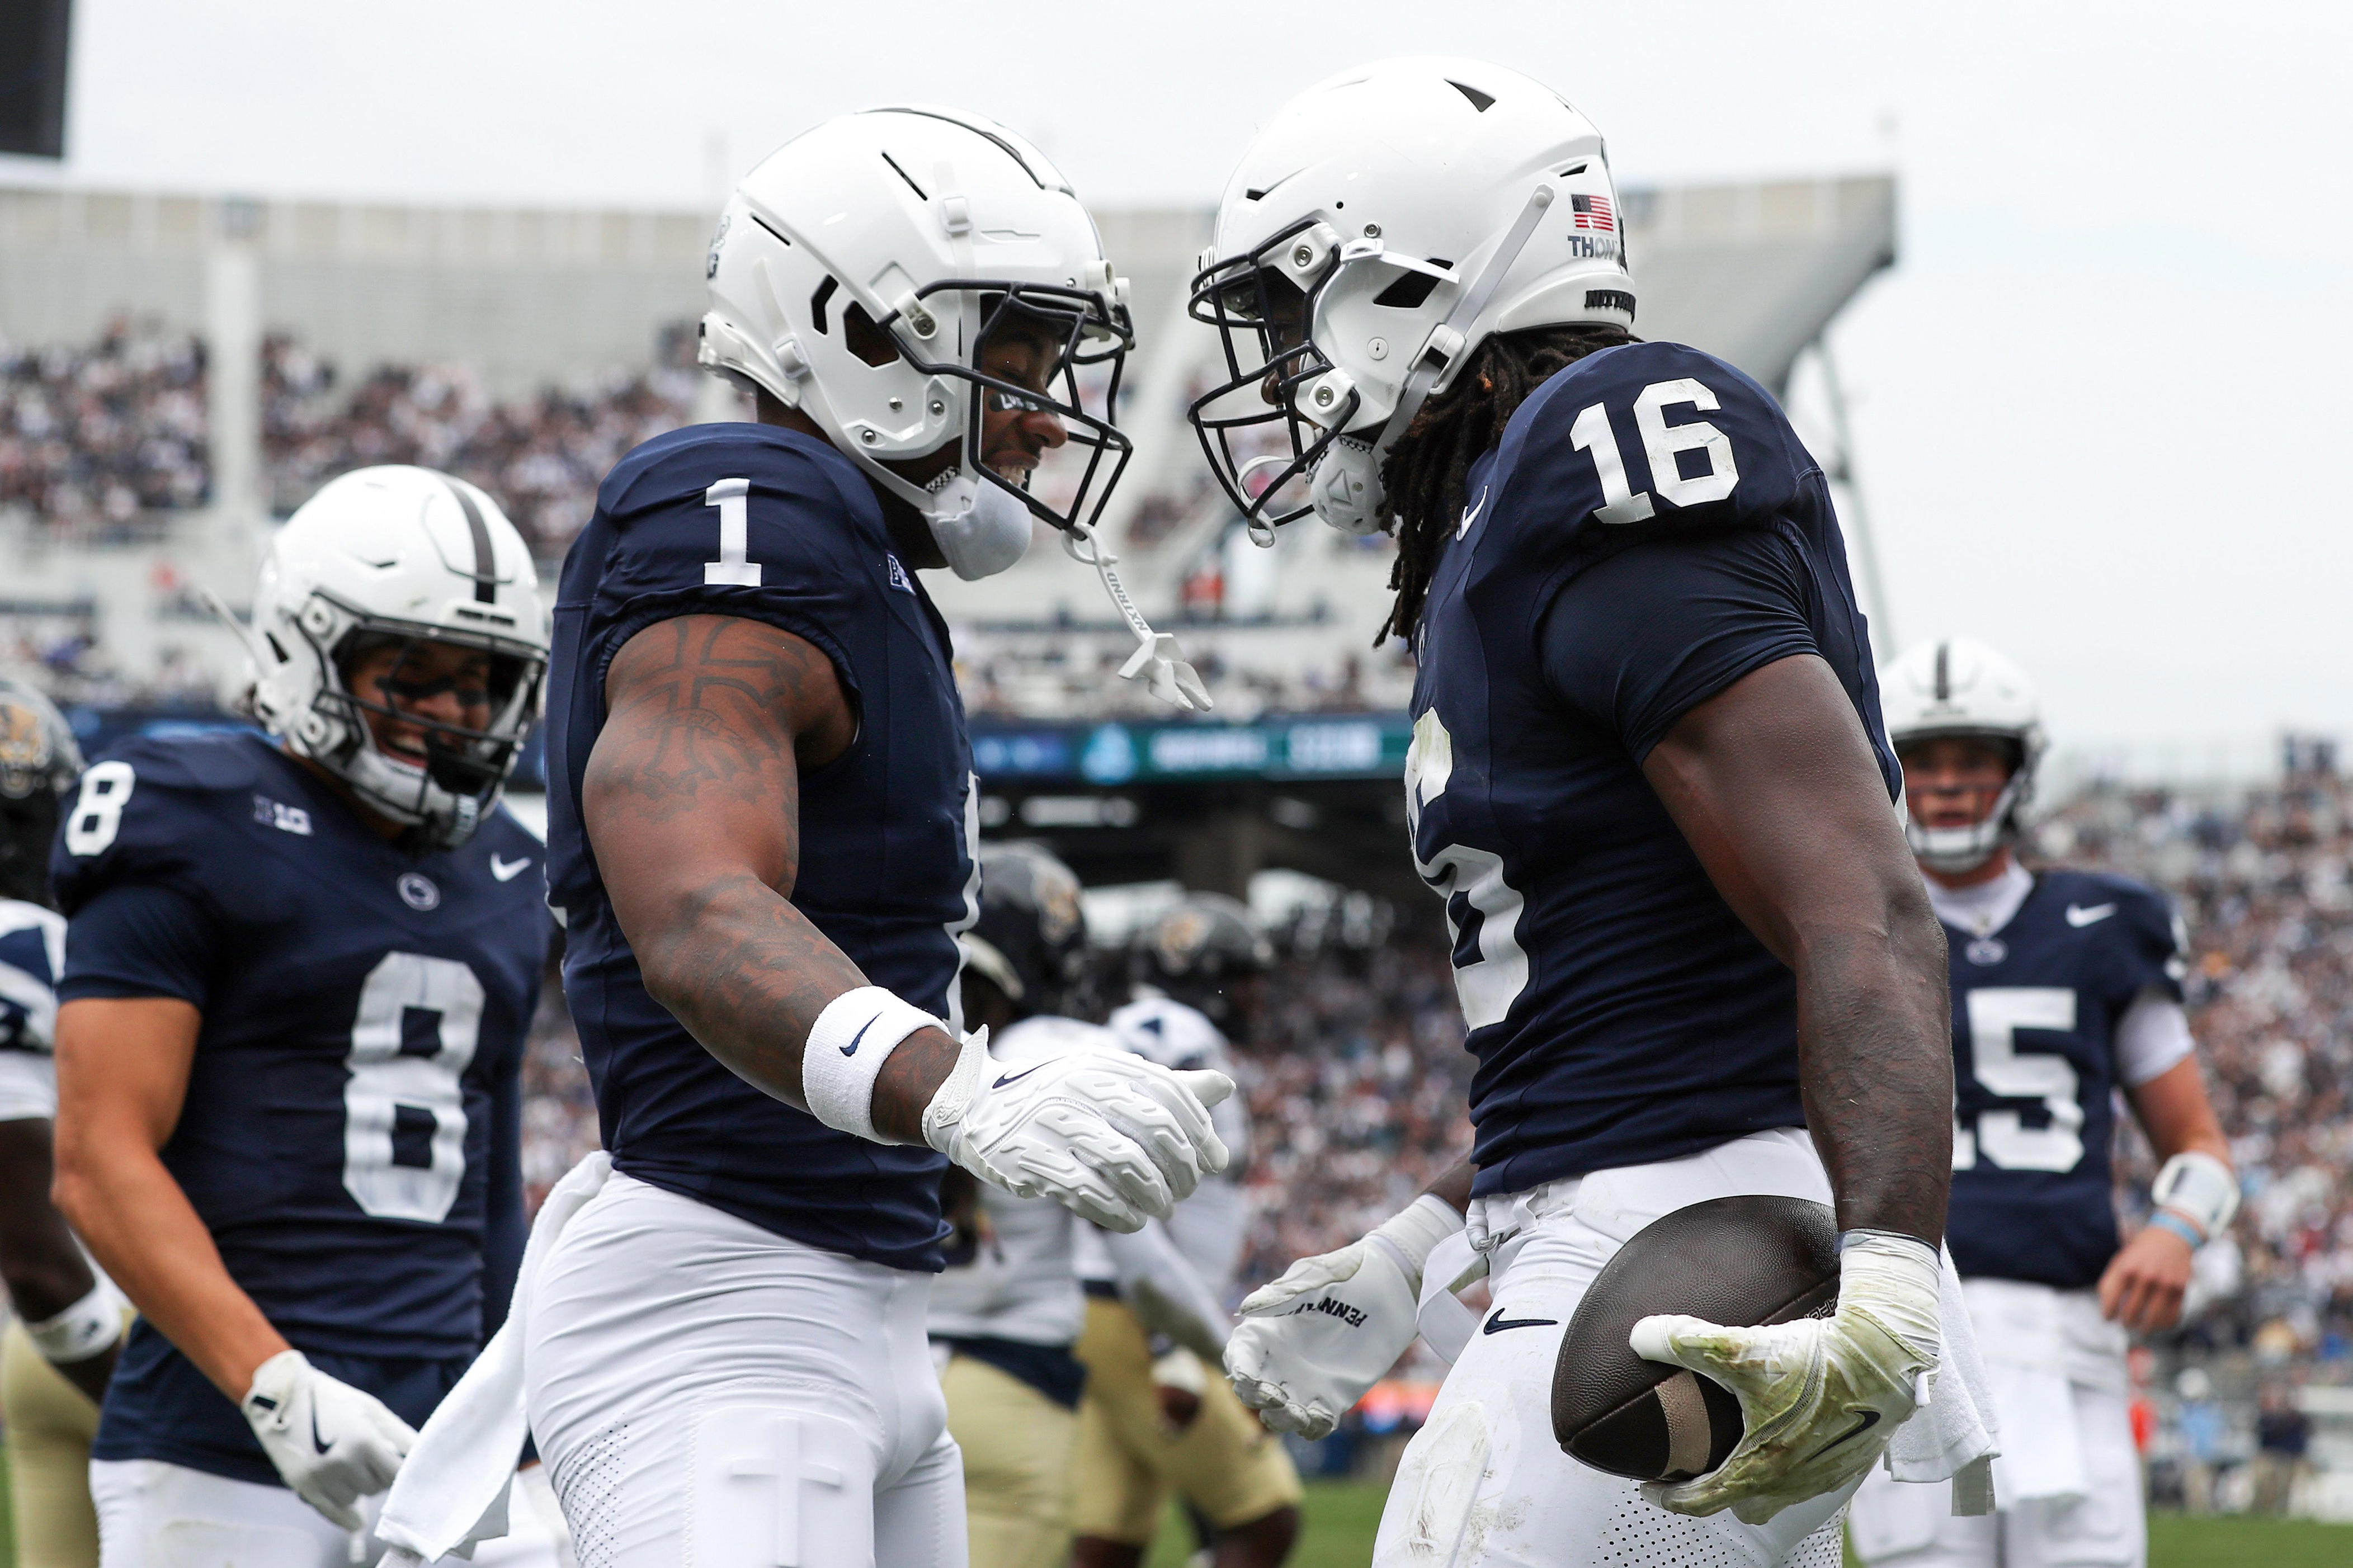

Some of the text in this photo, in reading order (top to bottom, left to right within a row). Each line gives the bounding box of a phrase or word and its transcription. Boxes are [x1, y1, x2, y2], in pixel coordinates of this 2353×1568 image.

[1568, 235, 1615, 260] THON
[1569, 377, 1740, 524] 16
[704, 478, 762, 587] 1
[1107, 573, 1148, 630] NXTRND
[65, 761, 135, 856] 8
[342, 951, 485, 1224] 8
[1951, 986, 2085, 1173] 5
[1319, 1296, 1368, 1328] PENN
